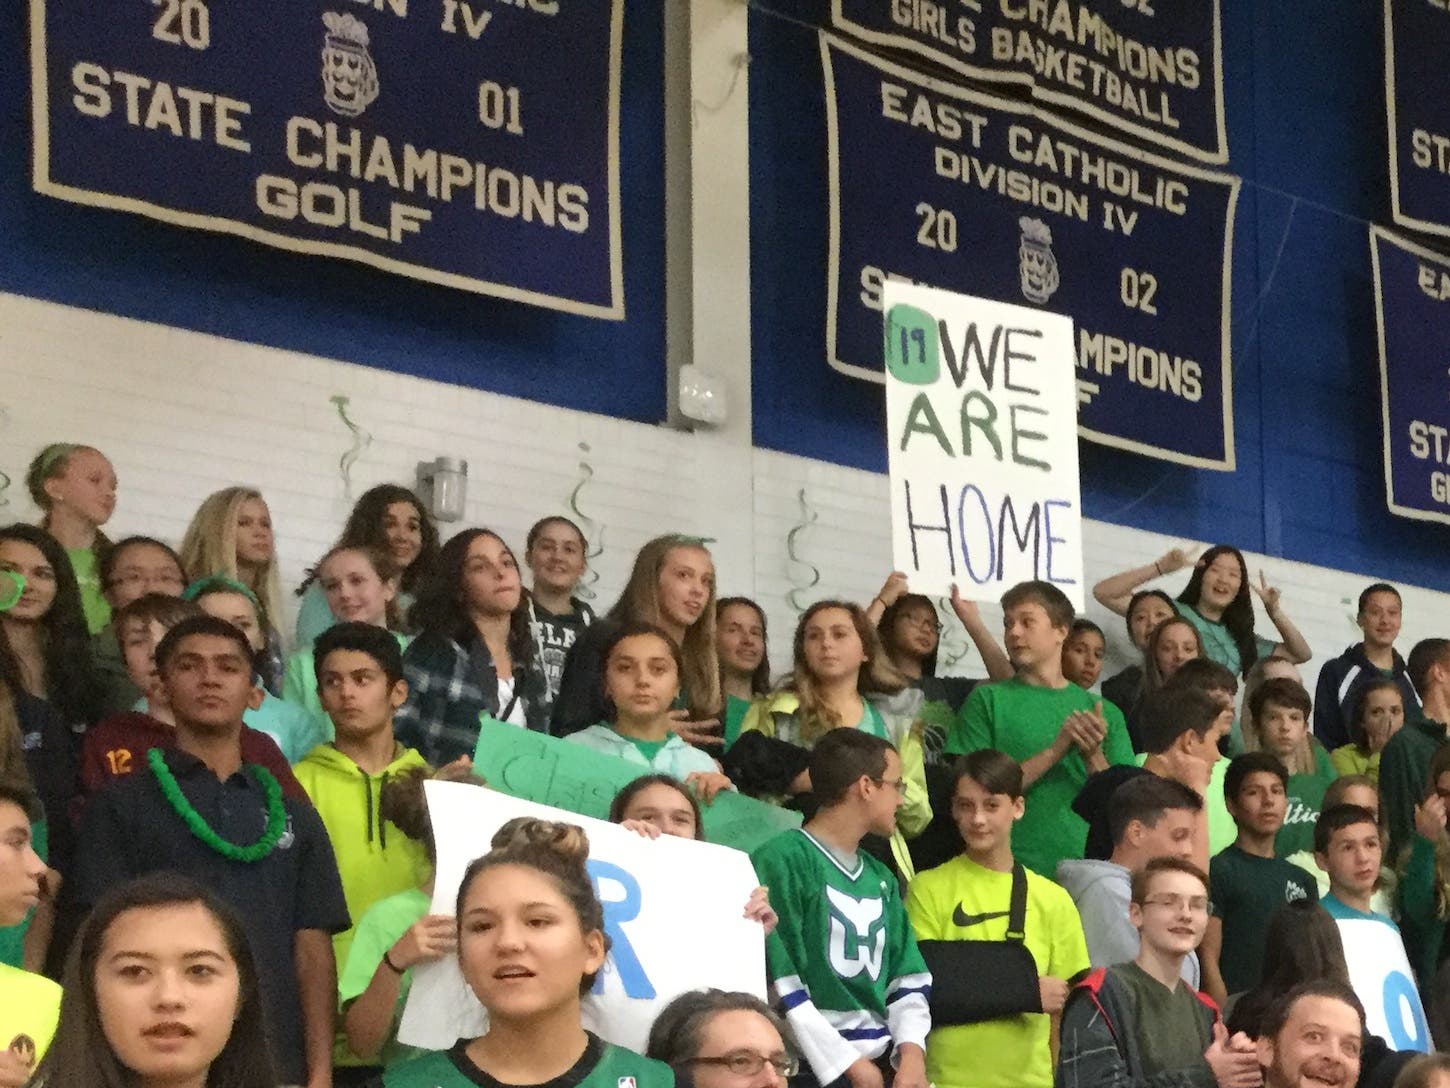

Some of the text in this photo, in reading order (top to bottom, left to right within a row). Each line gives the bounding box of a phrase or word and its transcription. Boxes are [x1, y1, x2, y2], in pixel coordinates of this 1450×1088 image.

[152, 0, 210, 49] 20
[440, 0, 492, 40] IV
[891, 0, 1180, 129] GIRLS BASKETBALL
[71, 61, 590, 234] STATE CHAMPIONS
[478, 80, 524, 136] 01
[880, 81, 1190, 216] EAST CATHOLIC
[255, 173, 432, 243] GOLF
[935, 146, 1139, 237] DIVISION IV
[916, 202, 1158, 316] 20 02
[899, 325, 926, 366] 19
[937, 317, 1043, 397] WE
[900, 389, 1052, 473] ARE
[904, 479, 1077, 585] HOME
[106, 748, 132, 775] 12
[583, 858, 658, 1000] R
